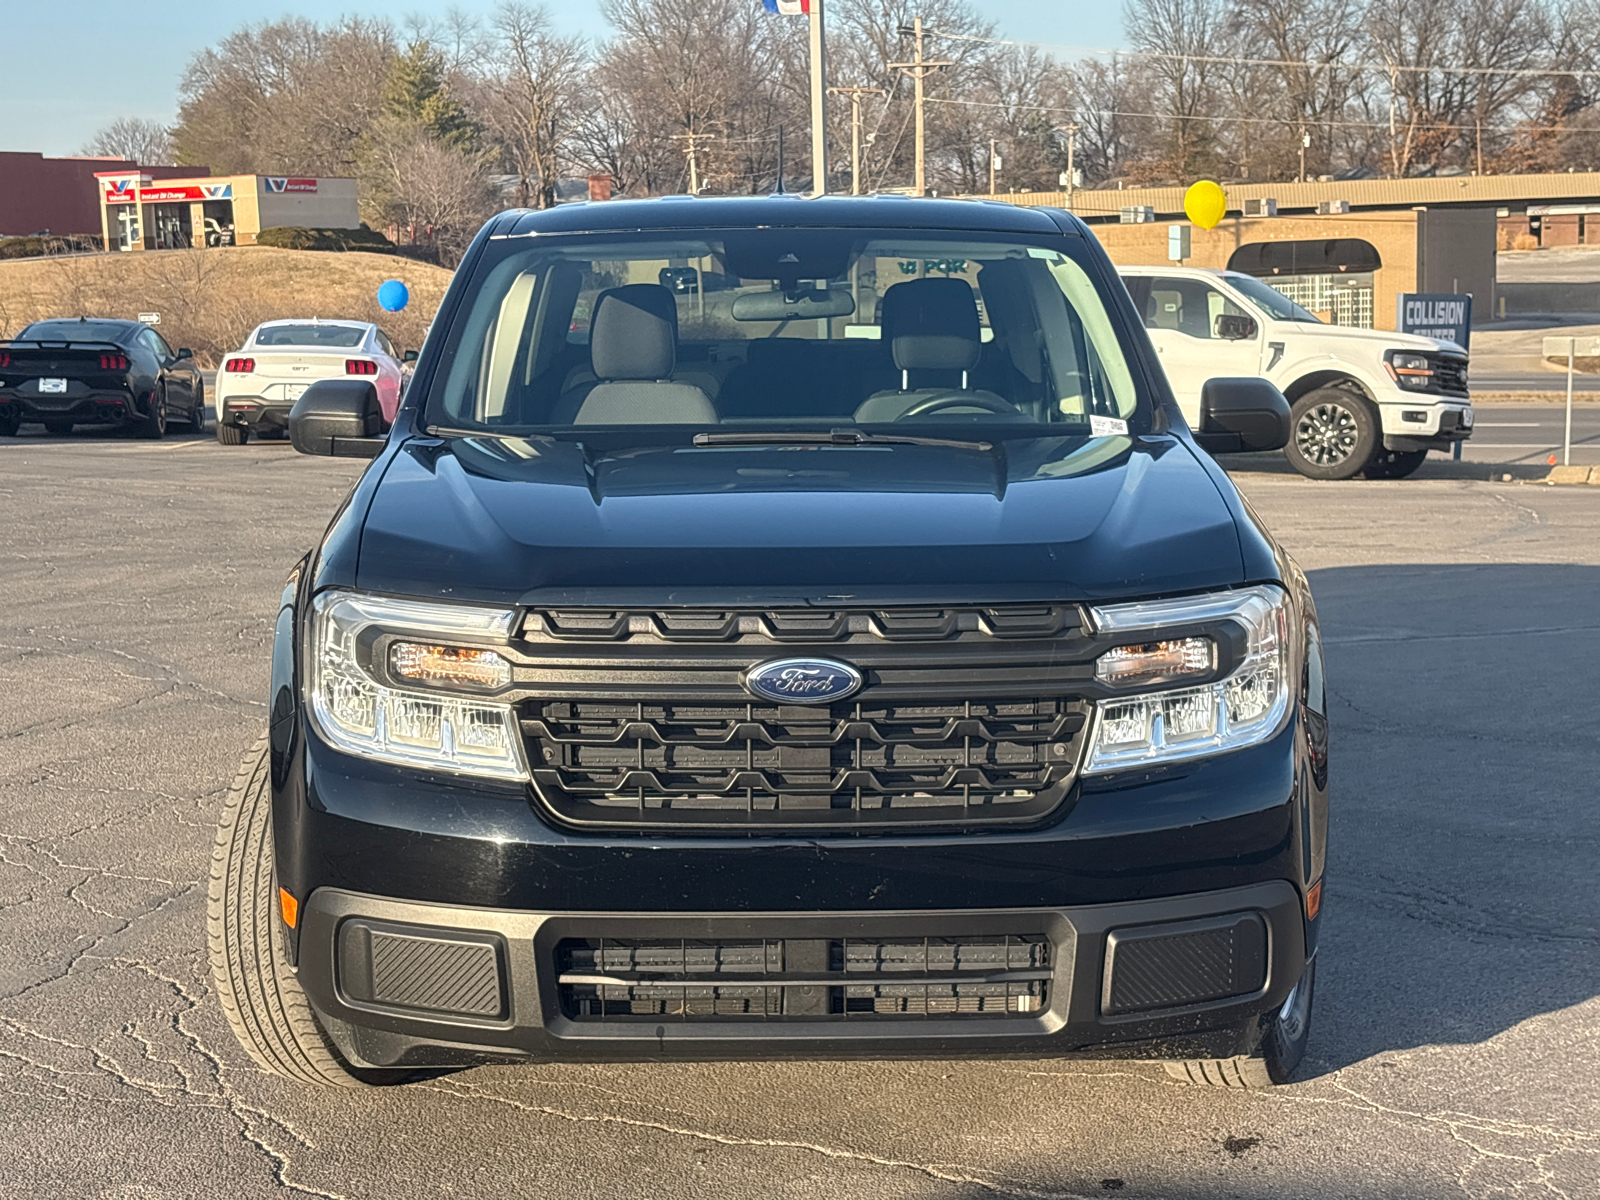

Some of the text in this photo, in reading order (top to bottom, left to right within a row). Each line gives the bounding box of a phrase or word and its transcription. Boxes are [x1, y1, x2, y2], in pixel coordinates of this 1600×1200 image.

[141, 192, 160, 200] Instant
[167, 191, 187, 199] Change
[1406, 301, 1464, 325] COLLISION
[776, 668, 834, 692] Ford
